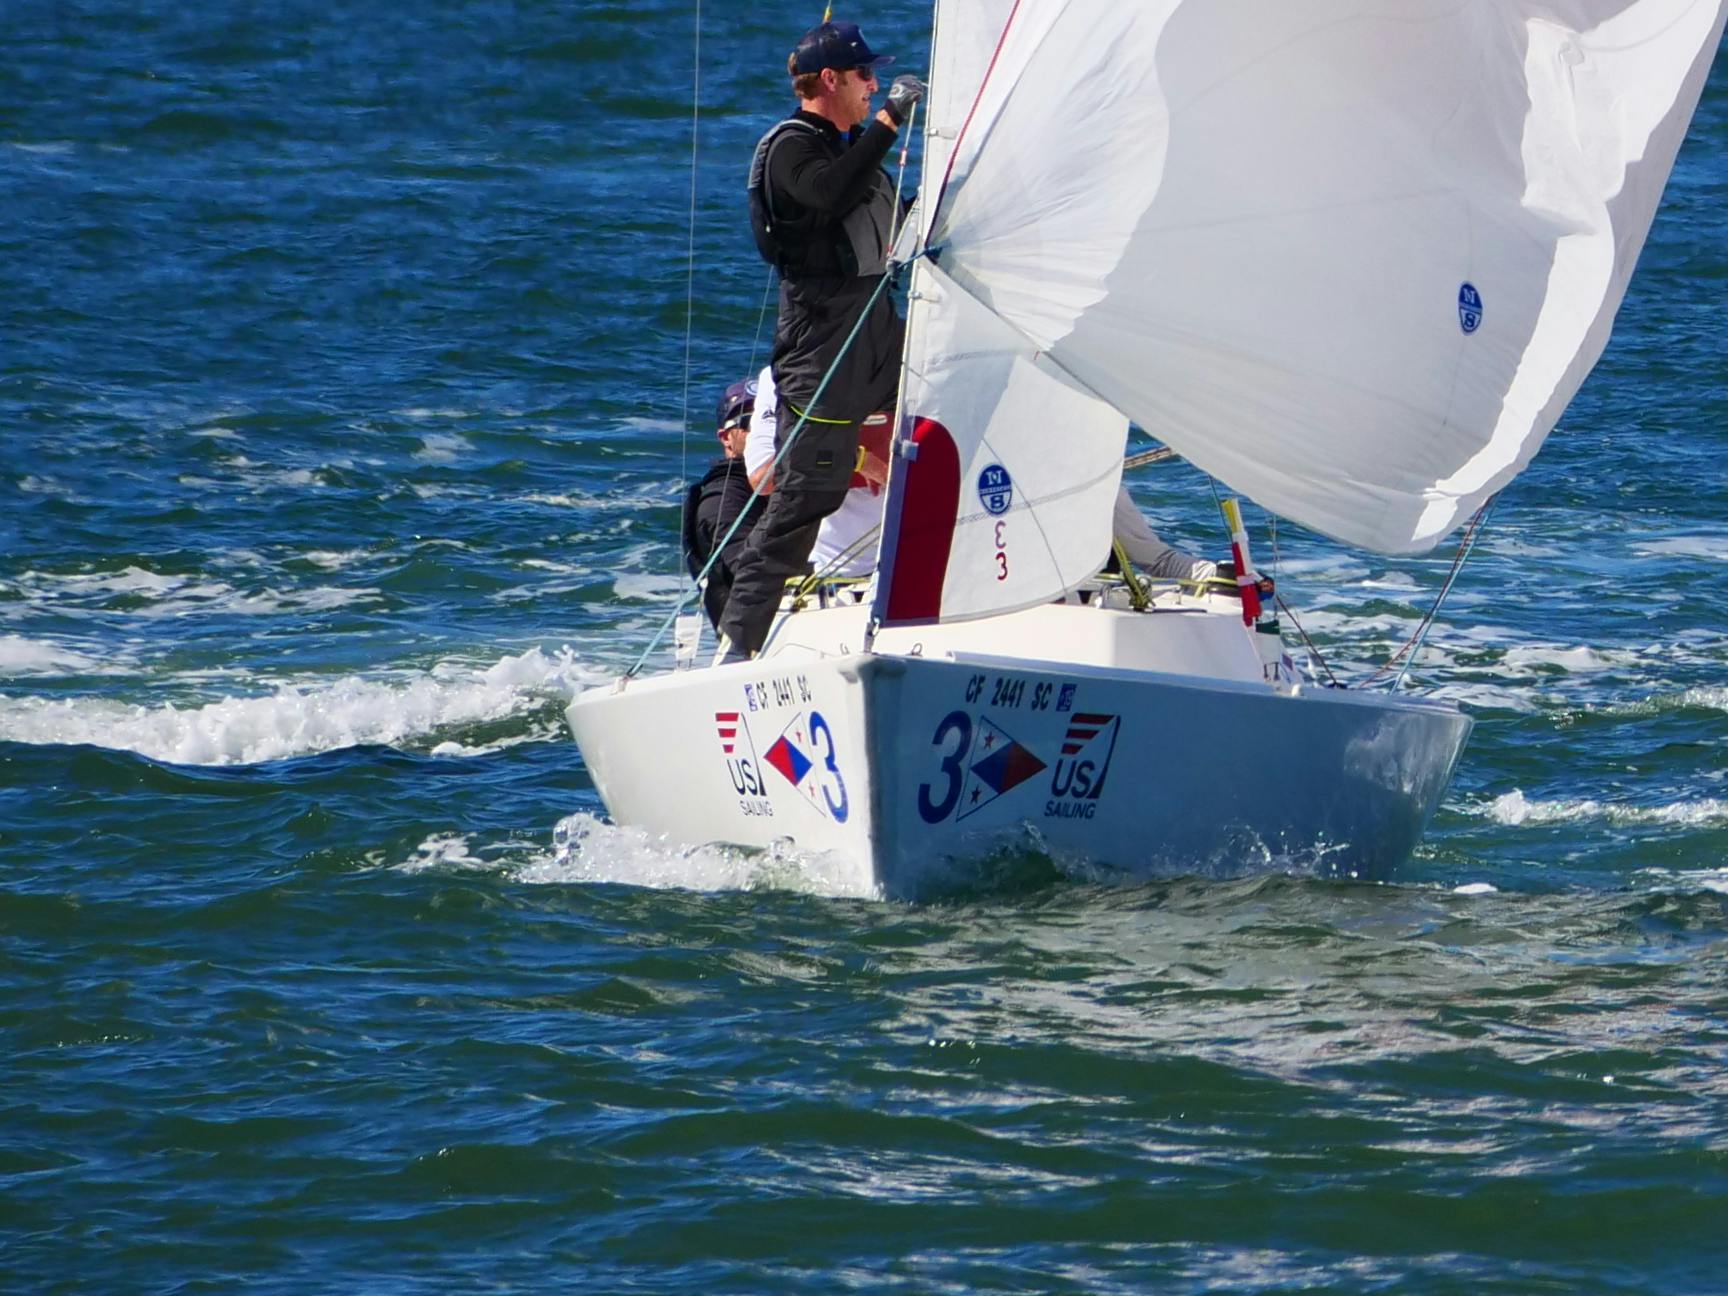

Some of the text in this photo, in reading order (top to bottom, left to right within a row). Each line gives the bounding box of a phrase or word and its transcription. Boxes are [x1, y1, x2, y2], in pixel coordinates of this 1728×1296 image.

[995, 552, 1008, 581] 3
[756, 681, 769, 710] CF
[965, 674, 986, 704] CF
[991, 678, 1026, 709] 2441
[1031, 682, 1052, 712] SC
[809, 710, 849, 824] 3
[918, 710, 973, 825] 3
[739, 799, 774, 817] SAILING
[1044, 799, 1097, 820] SAILING
